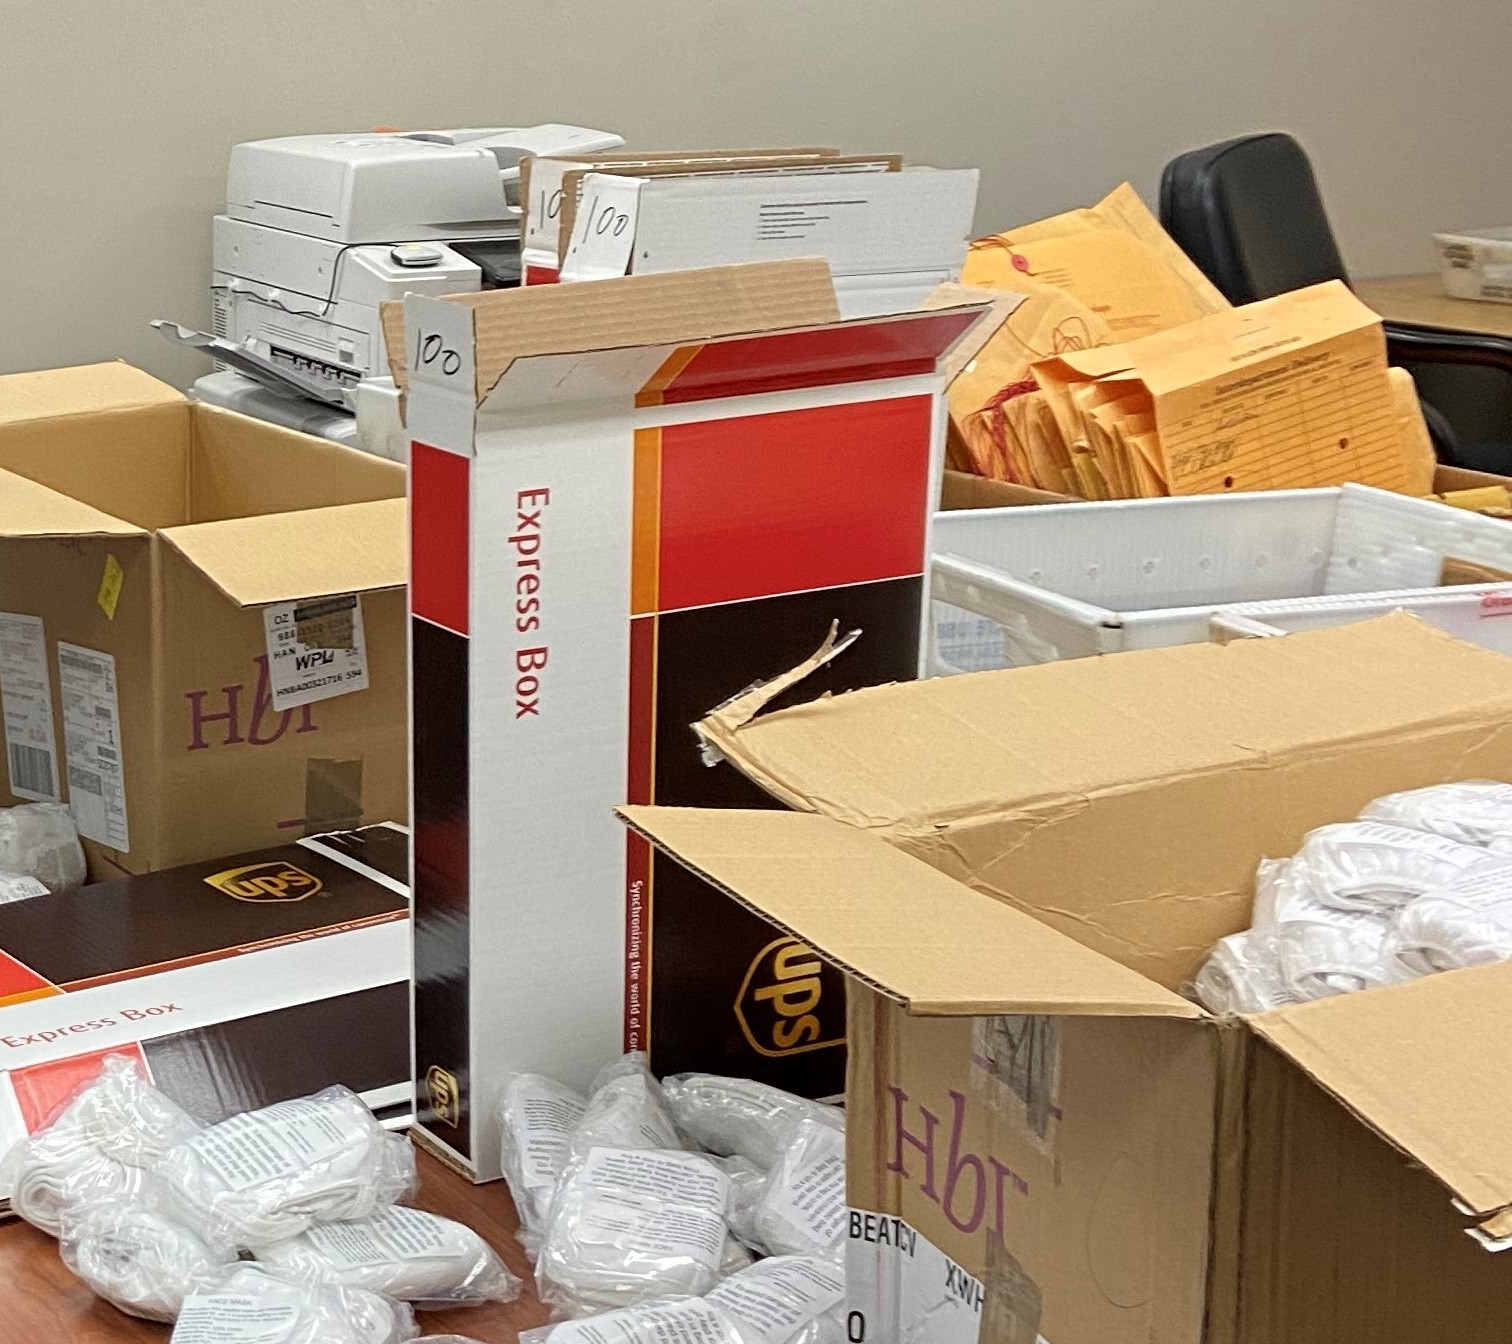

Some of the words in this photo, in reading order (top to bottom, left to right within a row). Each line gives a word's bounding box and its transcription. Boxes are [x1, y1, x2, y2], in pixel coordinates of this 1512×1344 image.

[583, 195, 629, 243] 100
[414, 328, 461, 375] 100
[508, 488, 549, 632] Express
[516, 647, 548, 719] Box
[231, 871, 312, 897] ups
[629, 880, 644, 959] Synchronizing
[630, 961, 641, 980] the
[629, 983, 641, 1015] world
[754, 942, 822, 1048] ups
[0, 1017, 117, 1048] Express
[120, 1003, 183, 1021] Box
[629, 1017, 641, 1029] of
